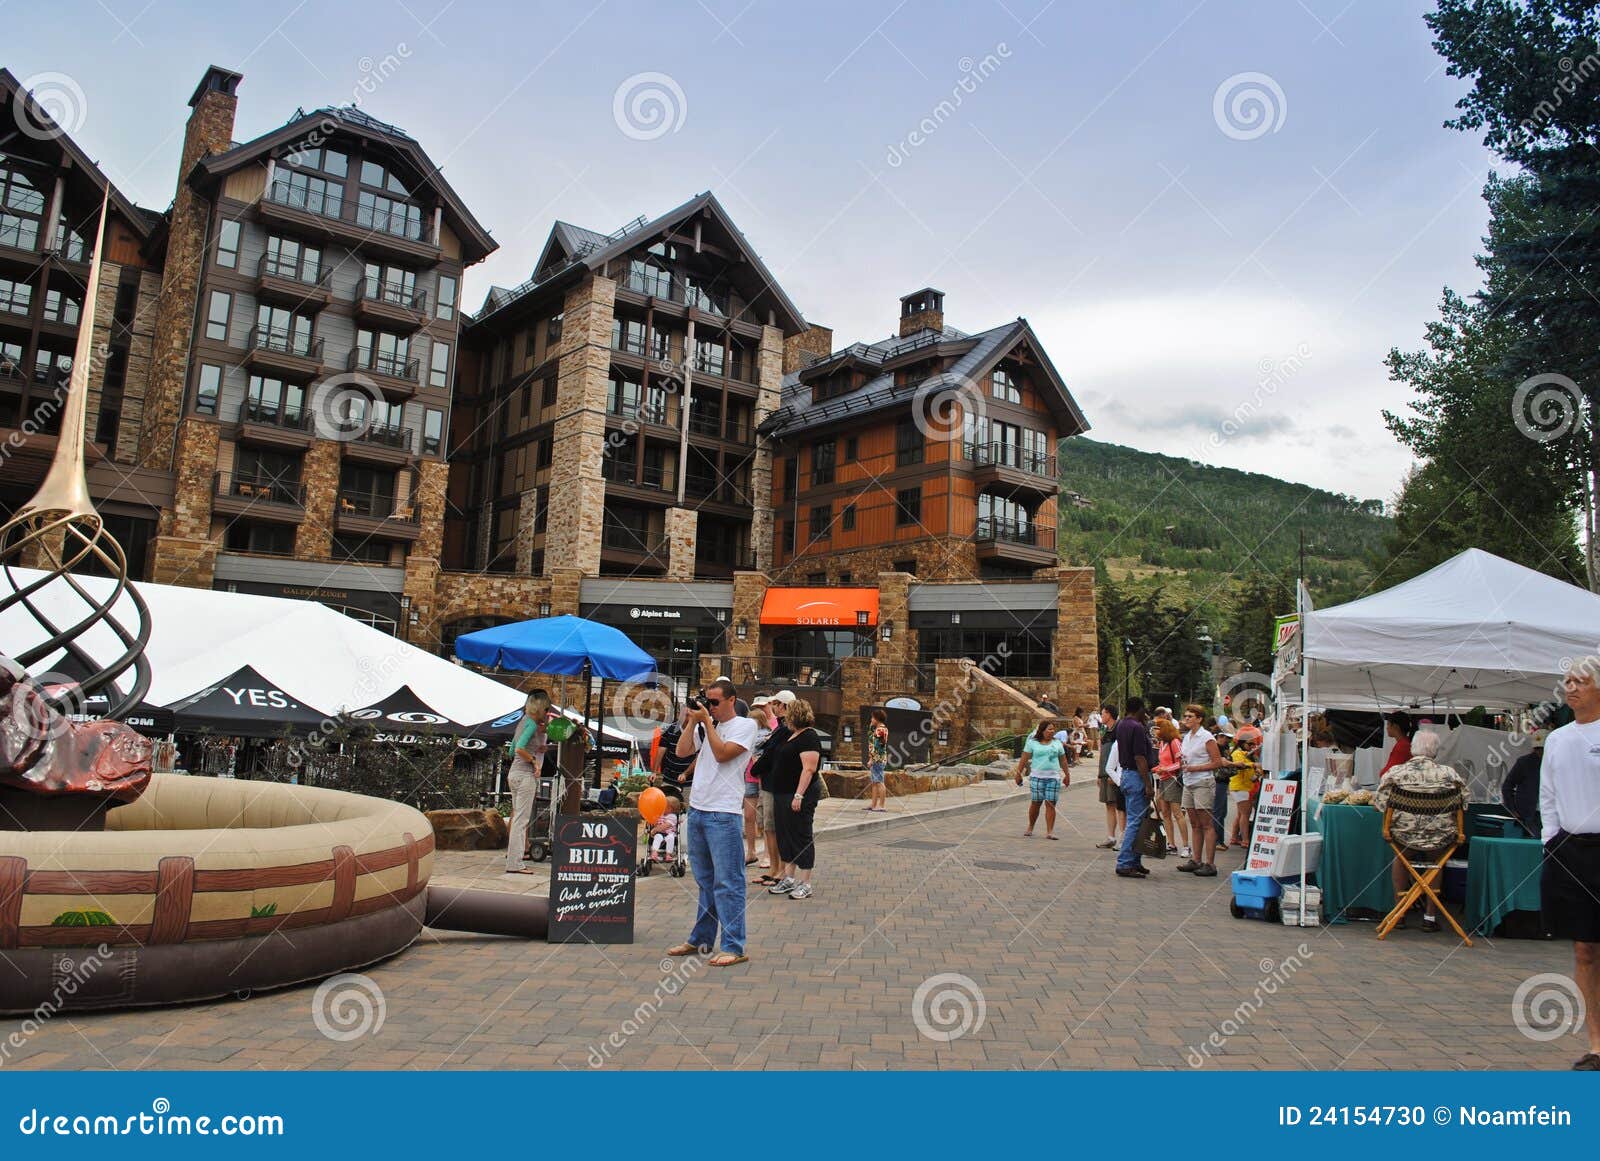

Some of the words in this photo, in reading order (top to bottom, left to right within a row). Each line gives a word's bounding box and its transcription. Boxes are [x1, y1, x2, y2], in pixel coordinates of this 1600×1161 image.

[641, 610, 663, 618] Alpine
[797, 617, 839, 625] SOLARIS
[222, 687, 298, 708] YES.
[581, 823, 609, 839] NO
[569, 848, 619, 865] BULL
[557, 873, 592, 882] PARTIES
[598, 874, 630, 883] EVENTS
[559, 887, 582, 902] Ask
[585, 882, 623, 898] about
[556, 902, 586, 922] your
[588, 890, 628, 909] event!
